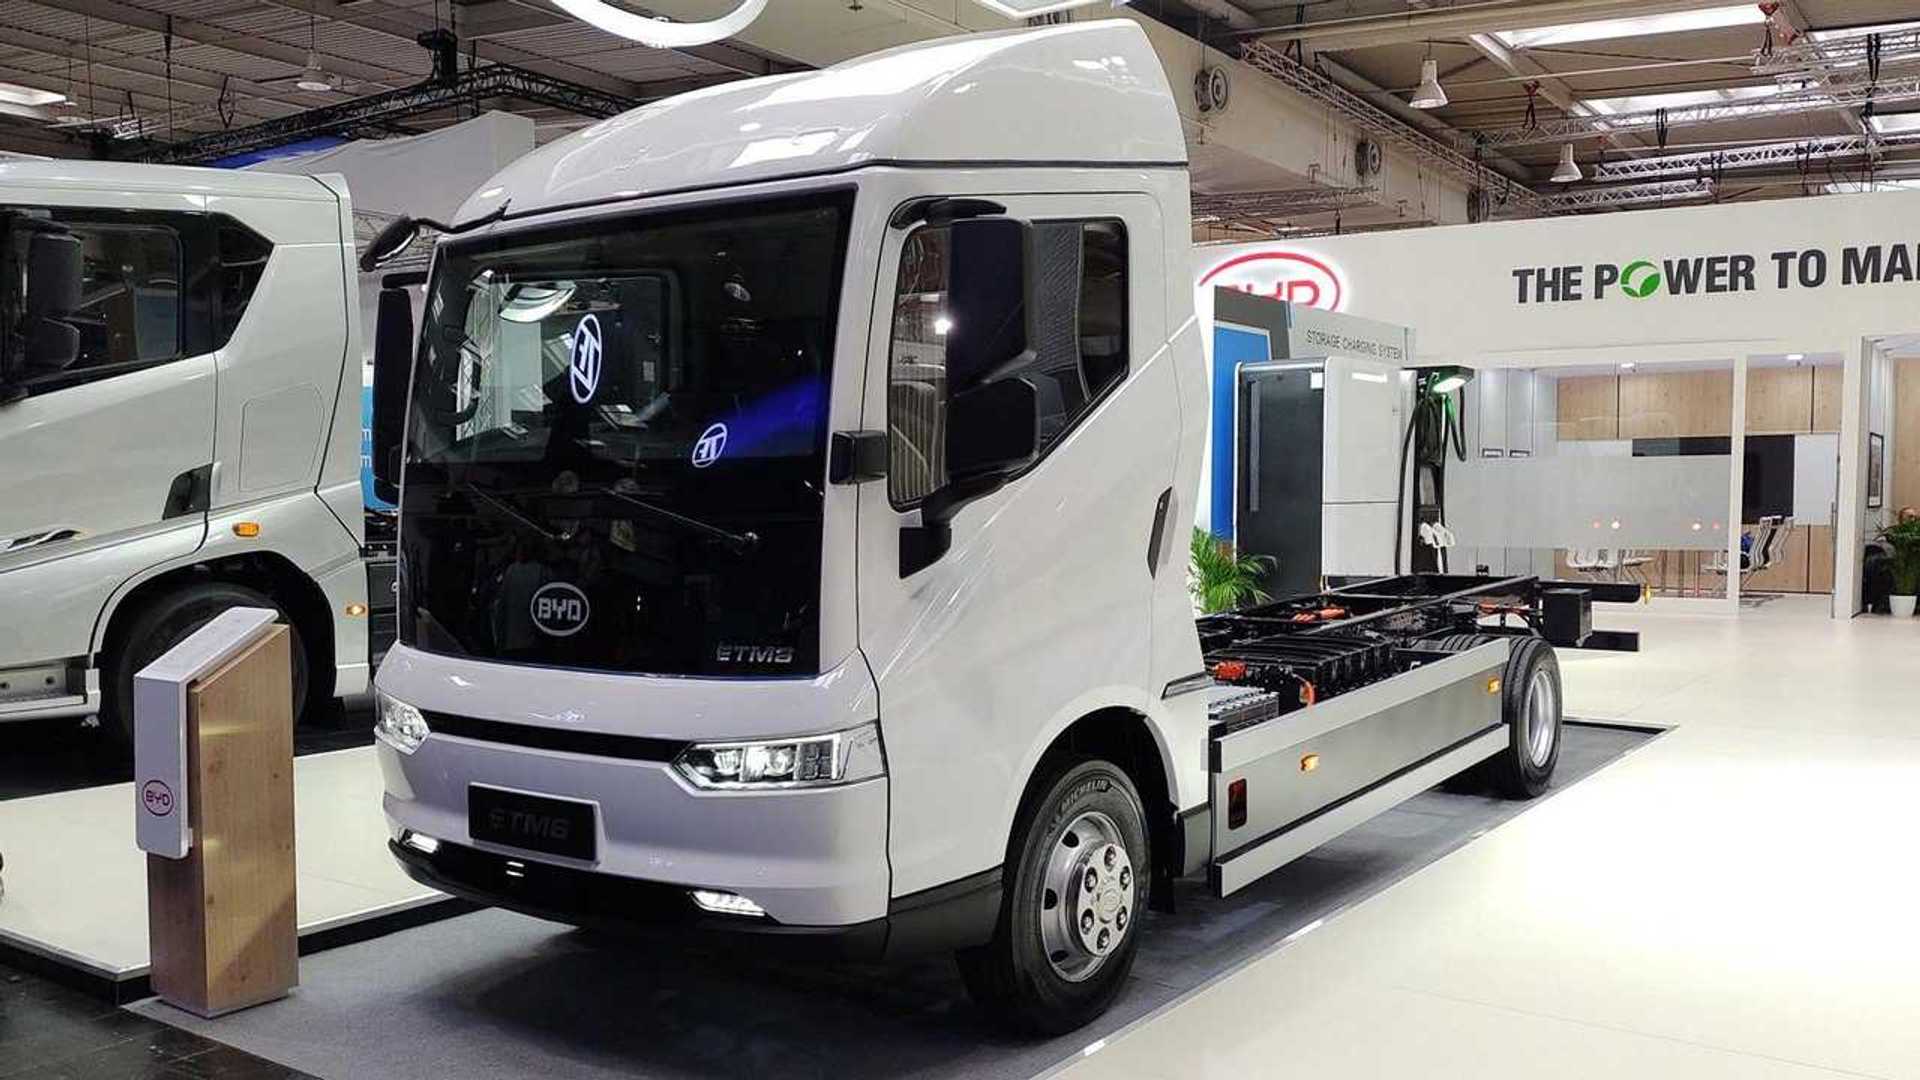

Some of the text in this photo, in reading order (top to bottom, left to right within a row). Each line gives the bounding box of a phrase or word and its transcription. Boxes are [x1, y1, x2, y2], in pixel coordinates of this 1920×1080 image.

[1512, 243, 1920, 303] THE POWER TO MA
[1306, 329, 1340, 350] STORAGE
[1342, 336, 1377, 356] CHARGING
[537, 597, 581, 621] BYD
[145, 789, 171, 807] BYD
[1060, 778, 1110, 813] MICHELIN
